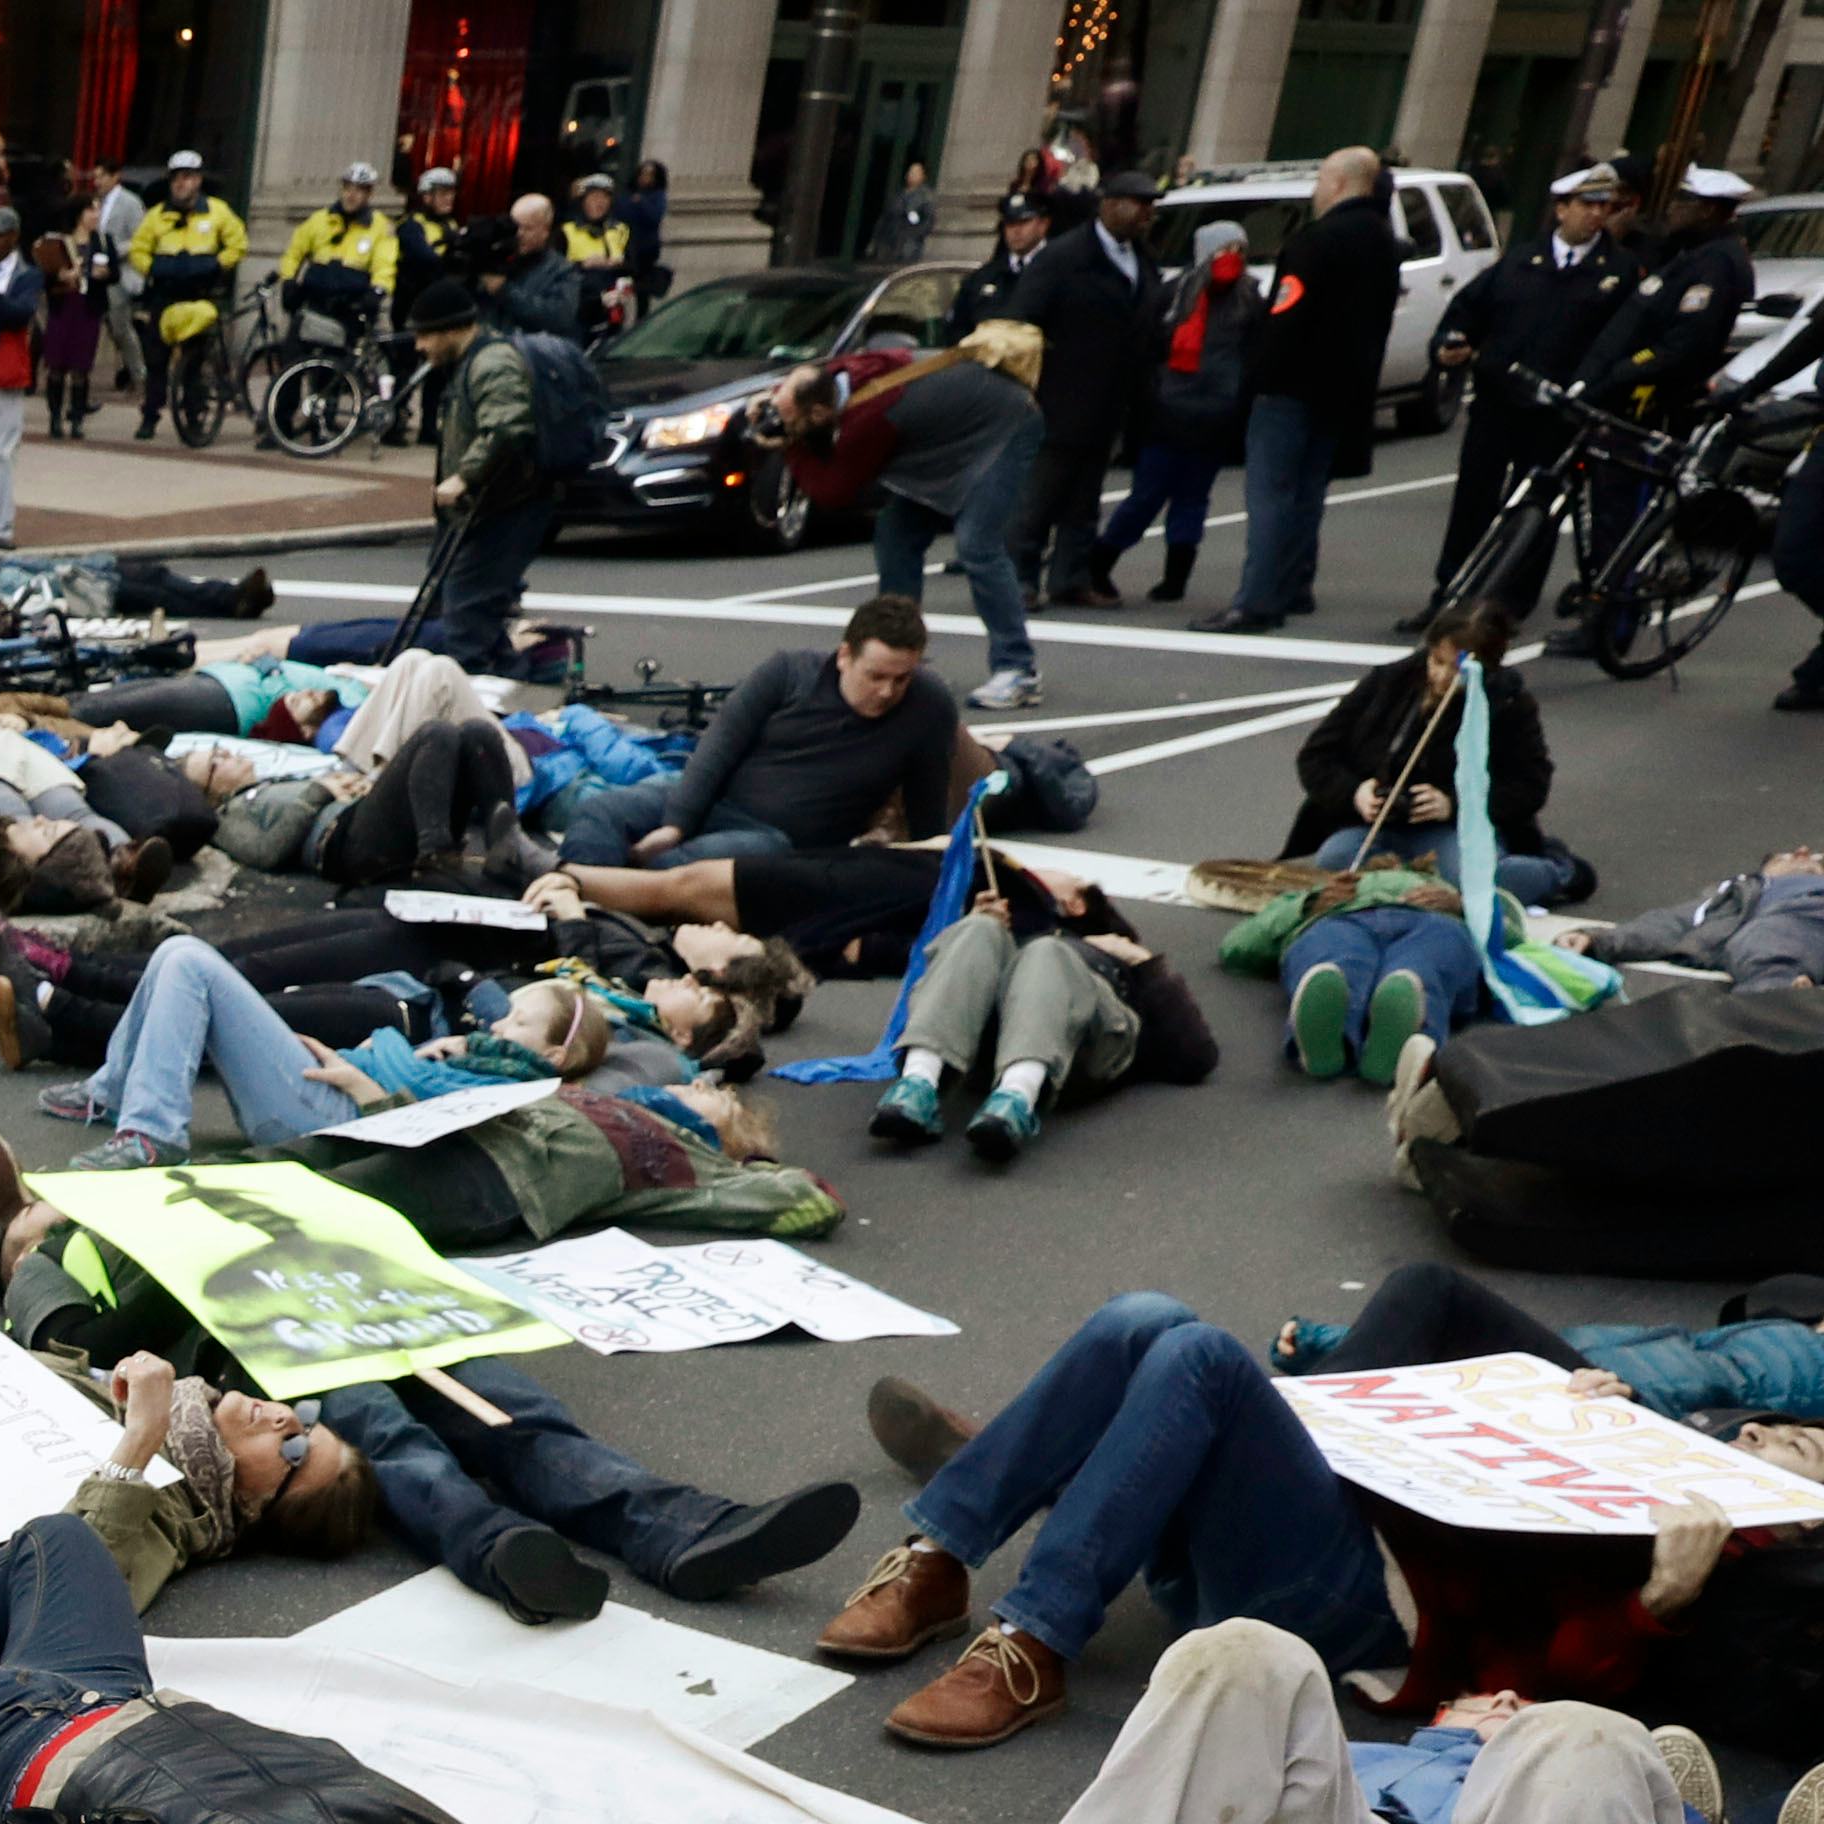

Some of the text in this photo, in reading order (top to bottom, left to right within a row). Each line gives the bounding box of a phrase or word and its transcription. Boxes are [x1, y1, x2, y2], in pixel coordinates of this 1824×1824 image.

[271, 1308, 495, 1351] GROUND
[588, 1286, 672, 1319] ALL
[617, 1261, 772, 1332] PROTECT
[1303, 1374, 1664, 1519] NATIVE
[1416, 1357, 1824, 1513] RESPECT
